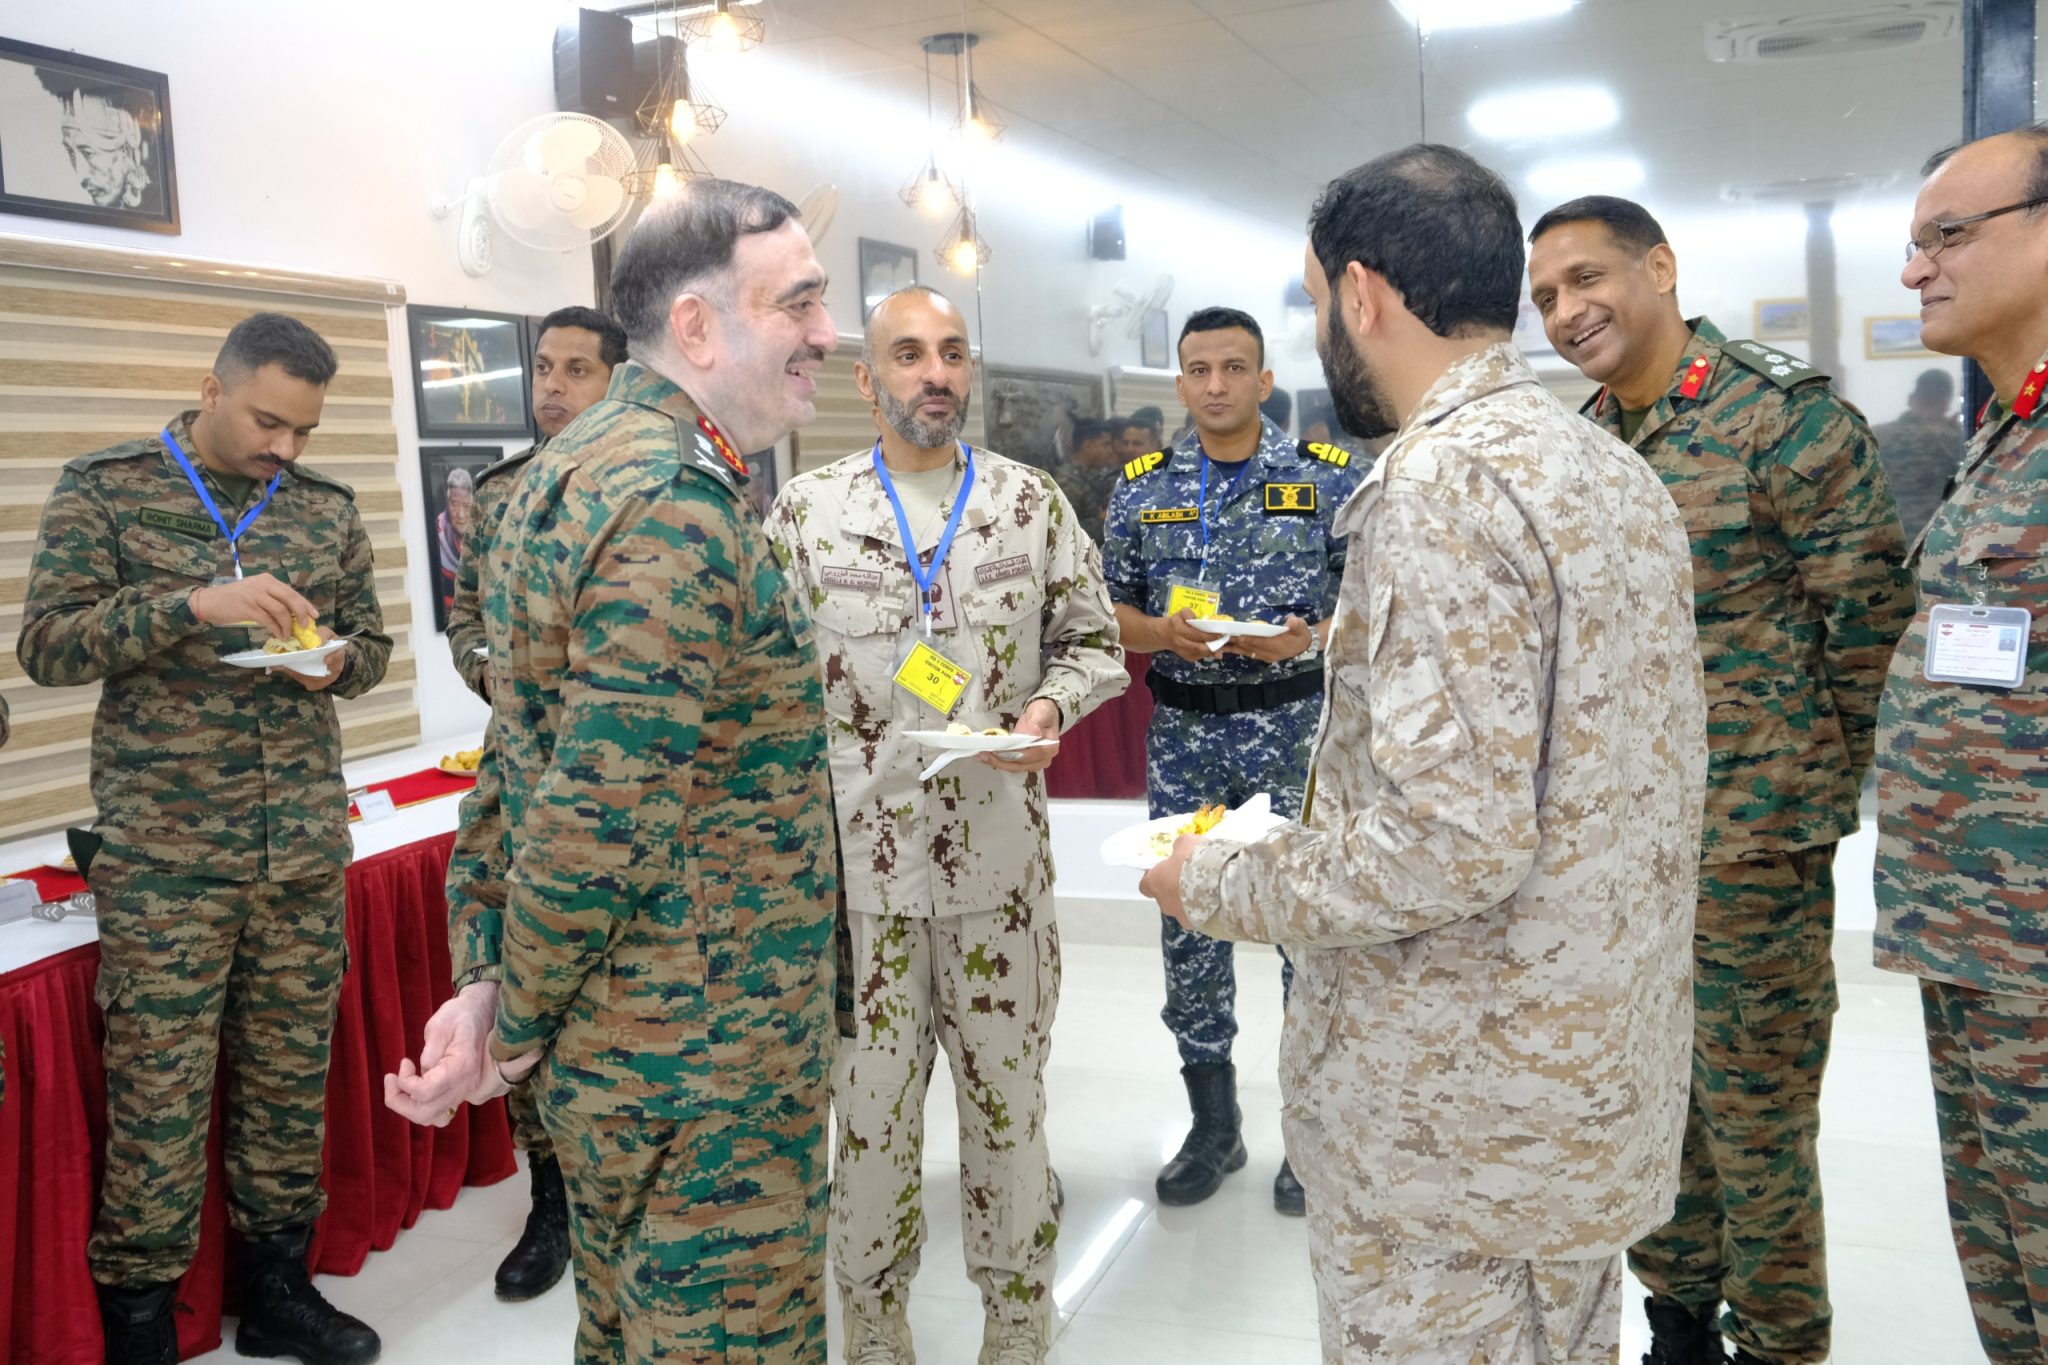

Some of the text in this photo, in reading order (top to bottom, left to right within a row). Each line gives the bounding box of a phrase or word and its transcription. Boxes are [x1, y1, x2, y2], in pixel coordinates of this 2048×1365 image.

[146, 512, 212, 533] ROHIT SHARMA
[924, 659, 941, 672] VISITOR
[940, 662, 954, 673] CORPS
[926, 672, 940, 685] 30
